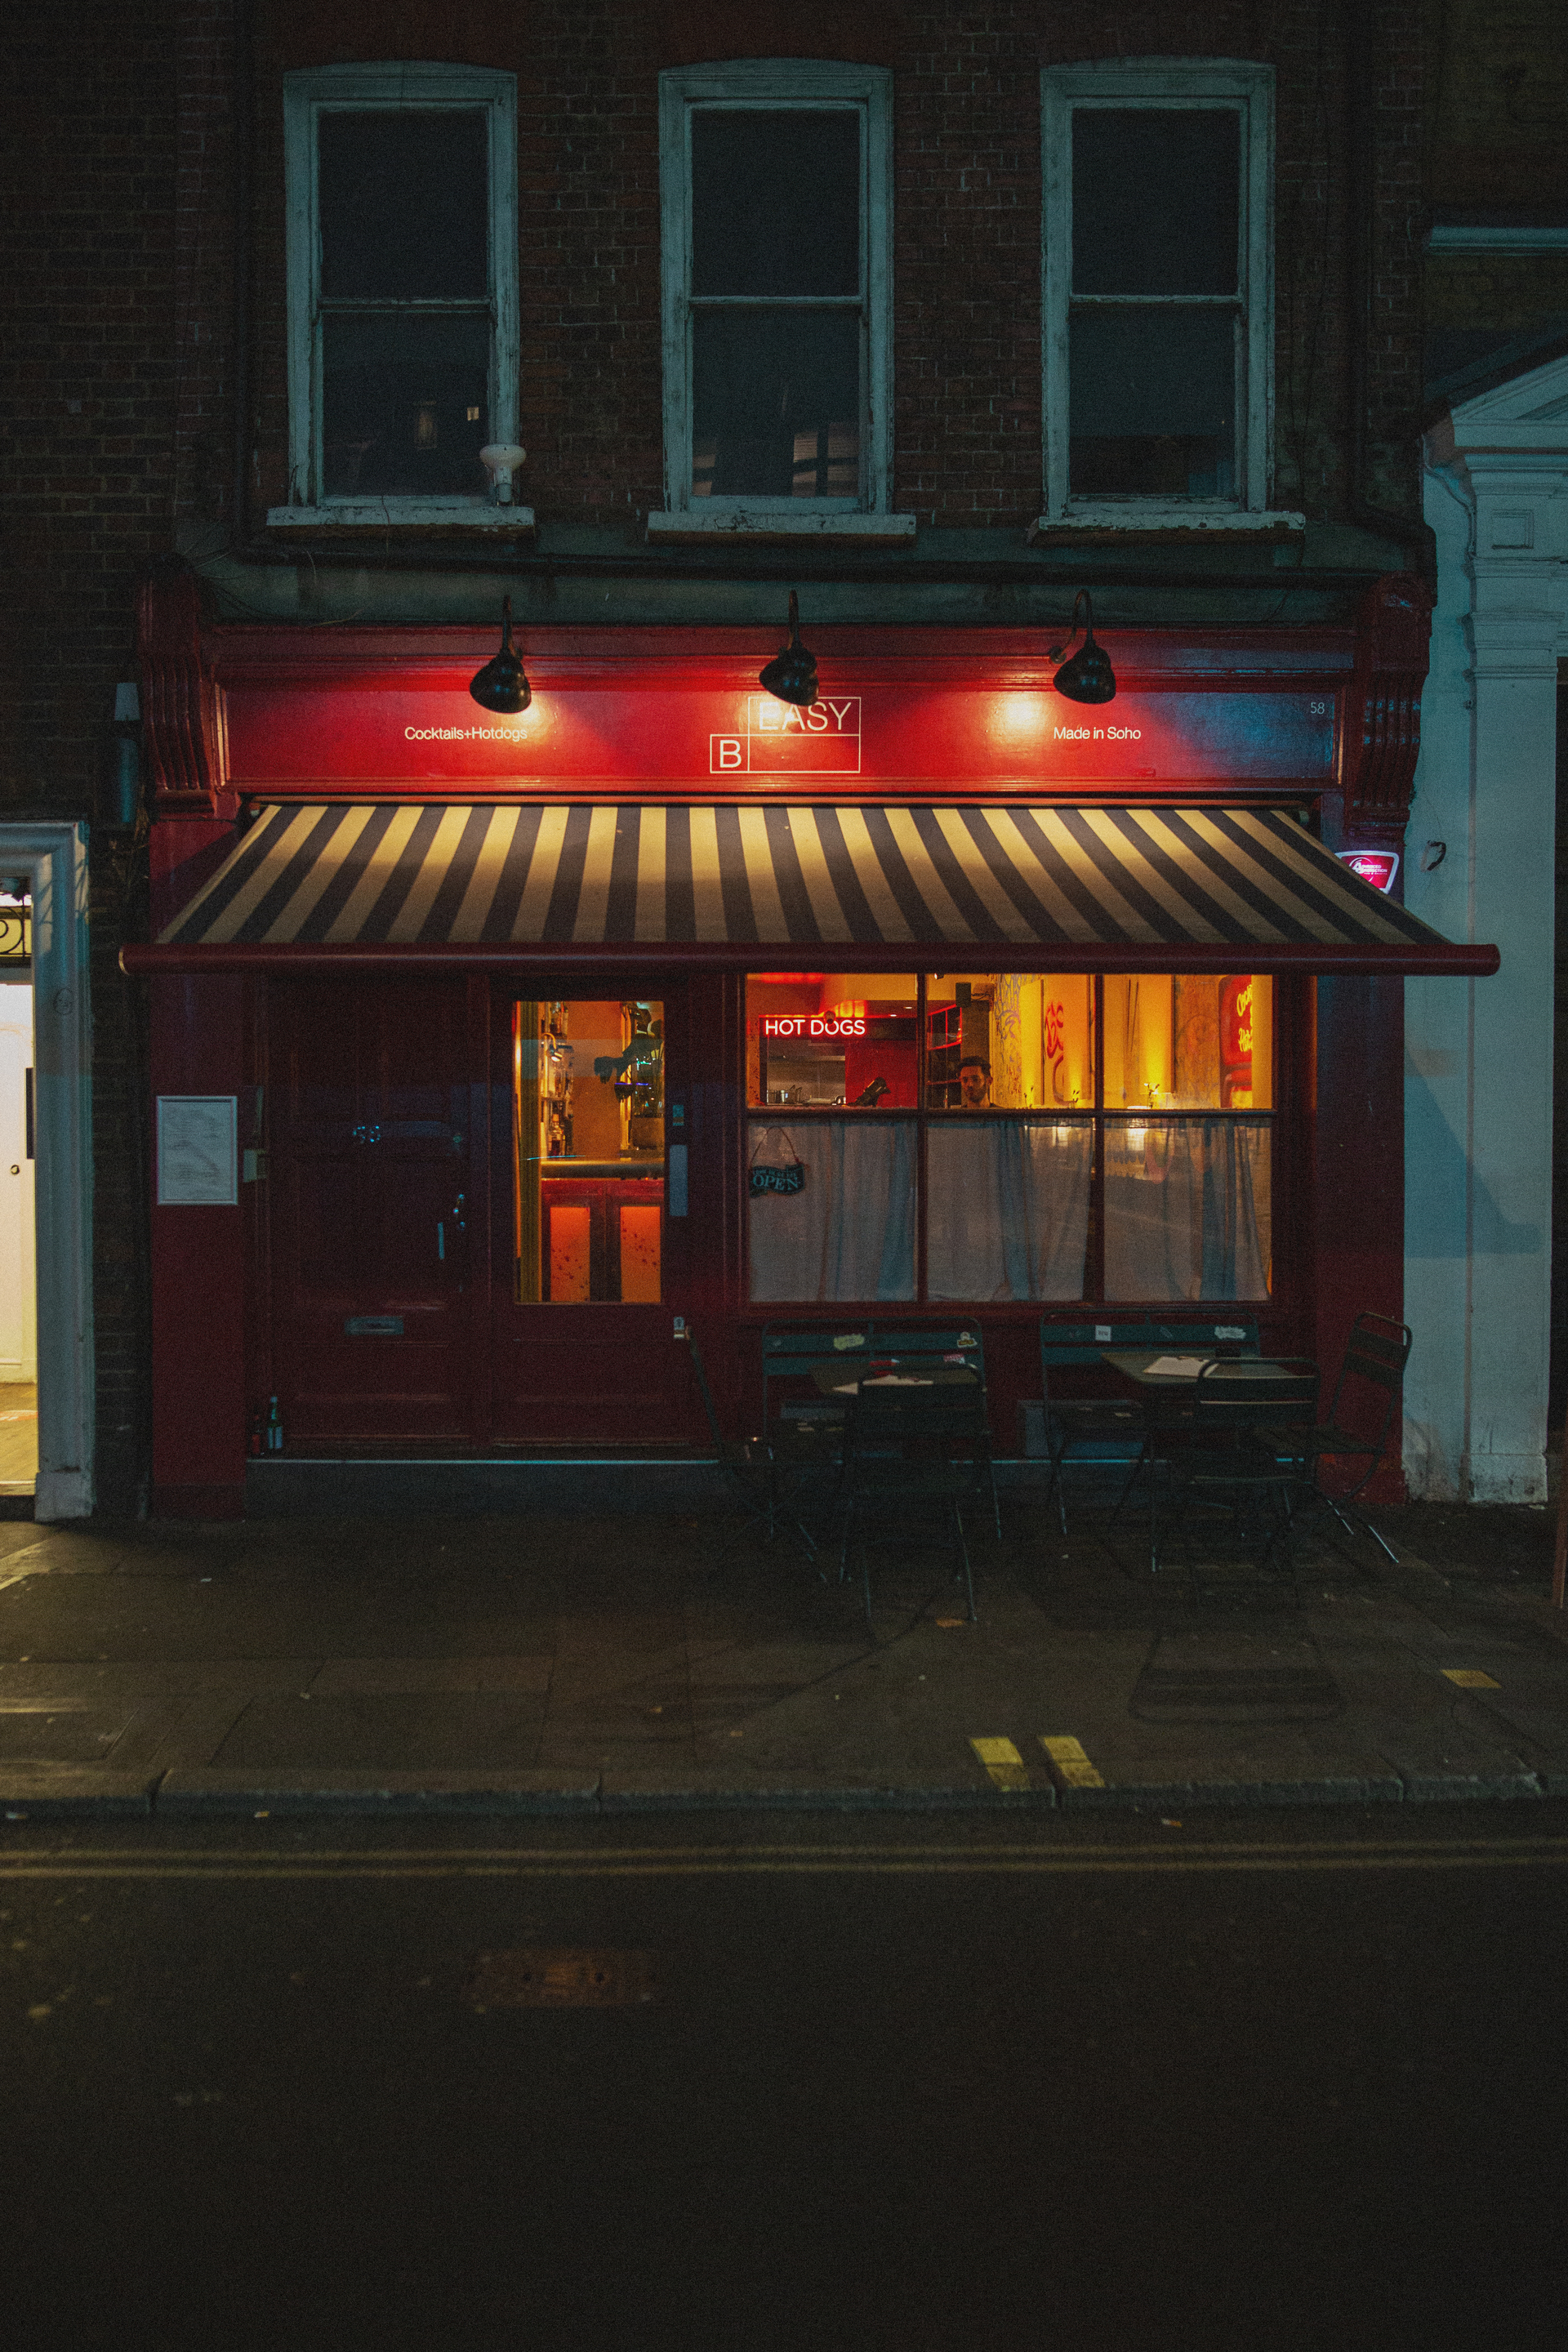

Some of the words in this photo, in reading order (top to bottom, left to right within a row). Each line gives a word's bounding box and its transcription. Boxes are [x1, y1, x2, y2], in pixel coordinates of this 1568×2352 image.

[759, 701, 852, 731] EASY
[1311, 702, 1325, 715] 58
[404, 726, 528, 742] Cocktails+Hotdogs
[1054, 726, 1090, 740] Made
[1093, 726, 1104, 740] in
[1107, 726, 1142, 740] Soho
[719, 739, 742, 768] B
[765, 1019, 806, 1036] HOT
[810, 1019, 866, 1036] DOGS
[752, 1174, 799, 1191] OPEN
